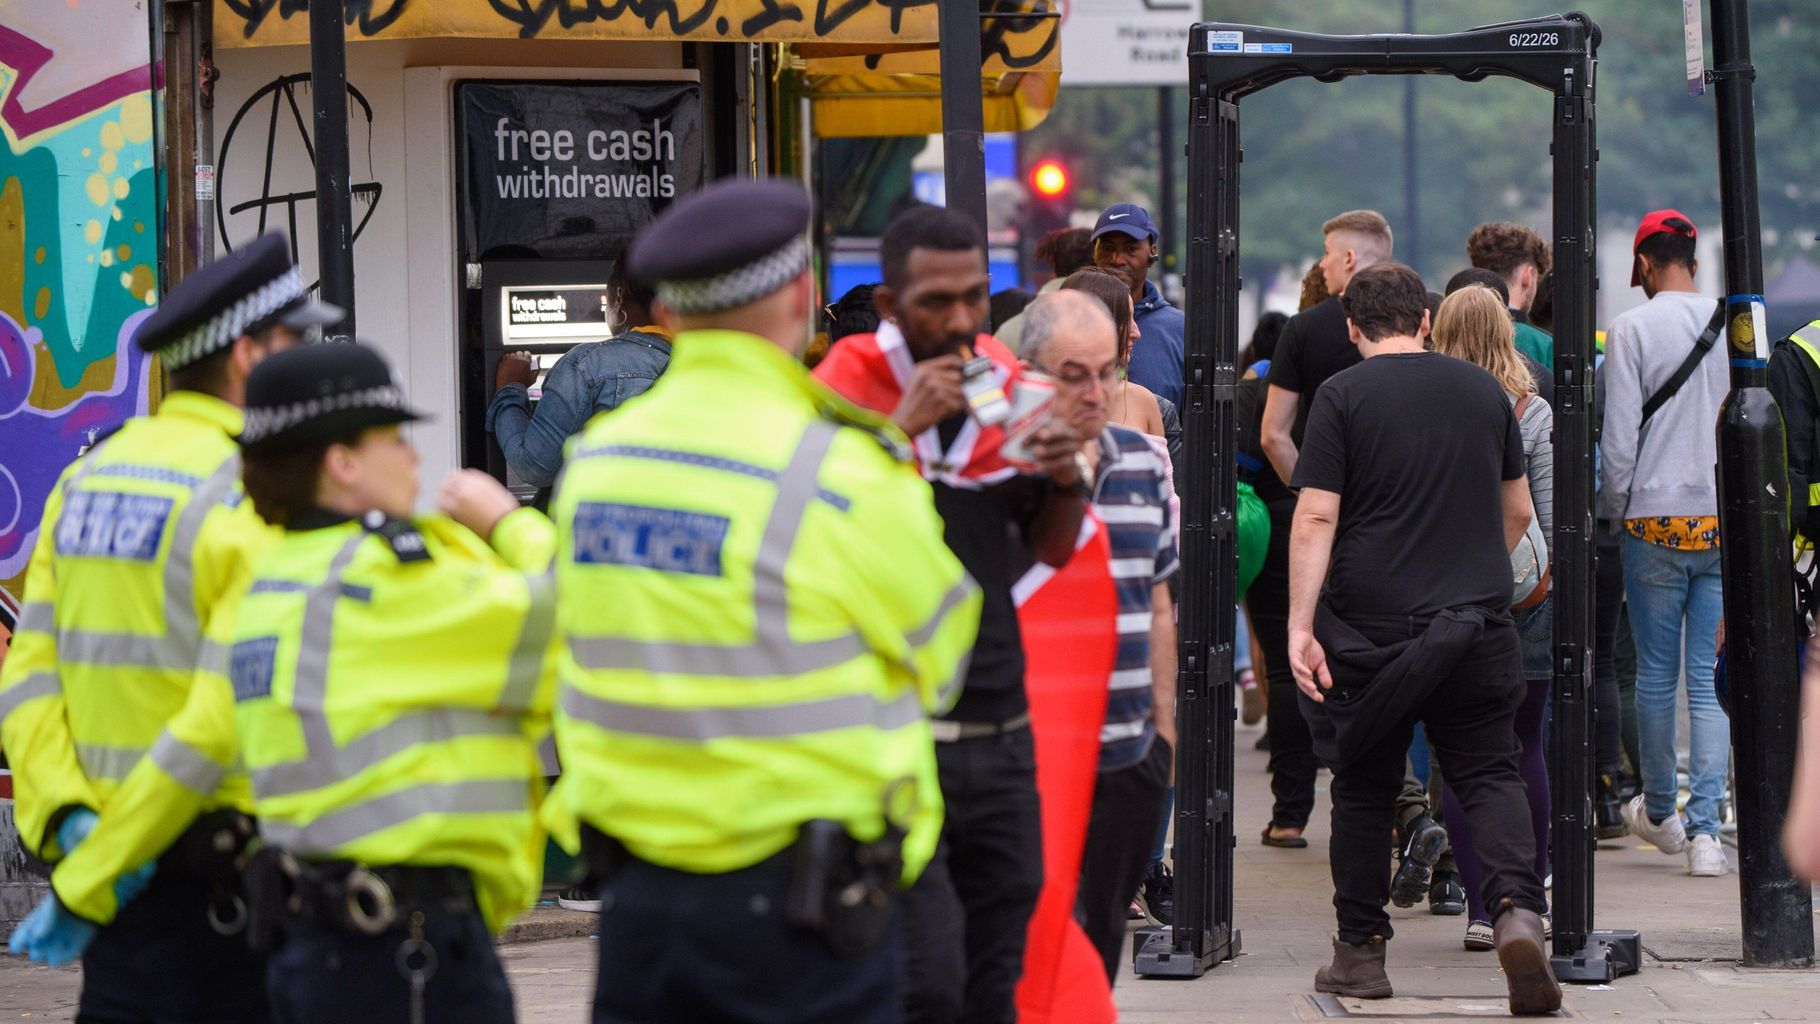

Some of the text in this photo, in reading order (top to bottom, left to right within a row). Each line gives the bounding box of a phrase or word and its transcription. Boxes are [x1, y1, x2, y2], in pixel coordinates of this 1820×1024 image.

[1509, 32, 1559, 47] 6/22/26
[1131, 47, 1179, 62] Road
[495, 117, 675, 161] free cash
[497, 165, 675, 198] withdrawals
[512, 295, 566, 311] free cash
[512, 310, 567, 323] withdrawals
[574, 520, 722, 576] POLICE
